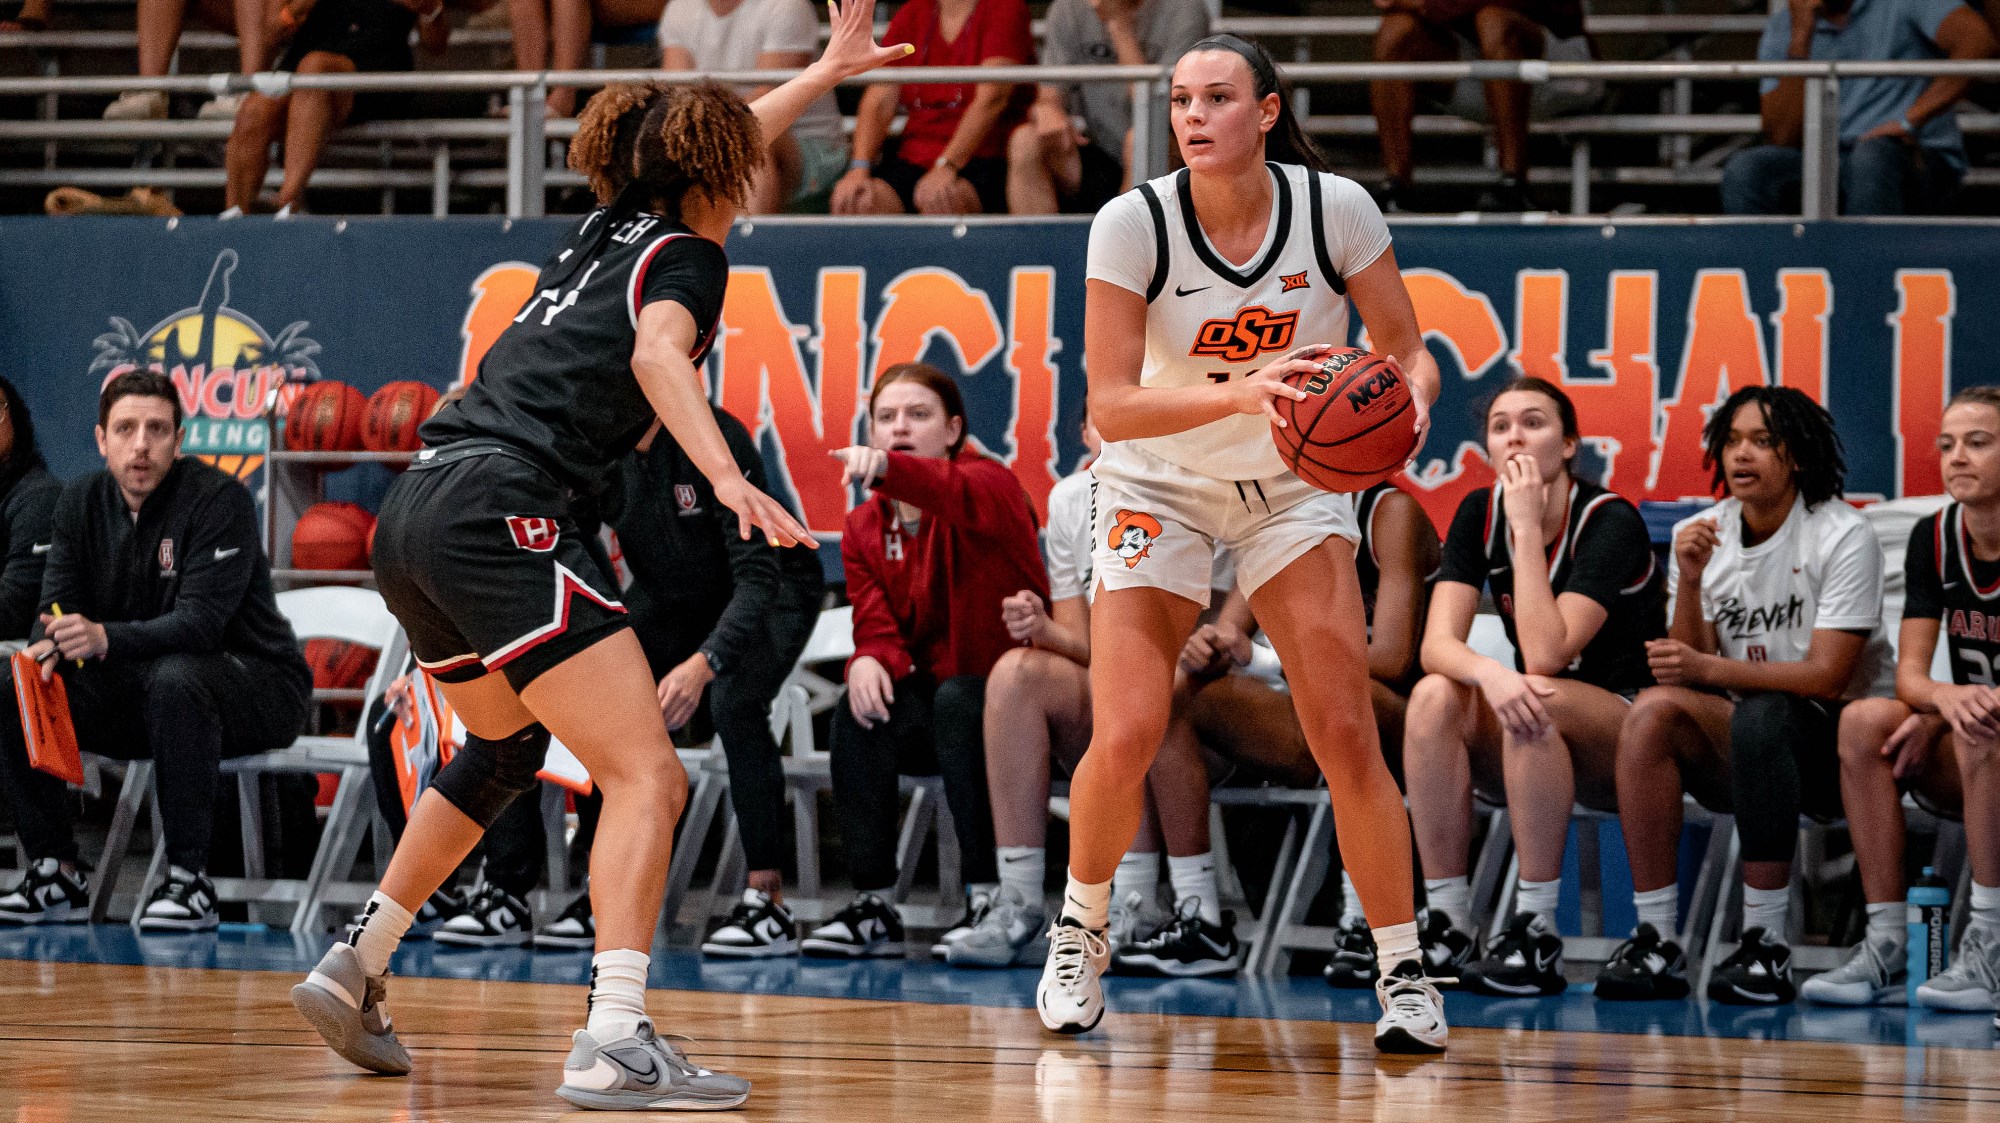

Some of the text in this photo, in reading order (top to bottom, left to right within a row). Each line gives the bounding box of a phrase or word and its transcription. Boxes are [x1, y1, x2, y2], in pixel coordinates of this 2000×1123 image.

[1189, 305, 1300, 363] OSU
[1346, 367, 1400, 413] NCAA
[521, 517, 550, 545] H
[885, 532, 904, 561] H
[1930, 907, 1942, 979] POWERAD
